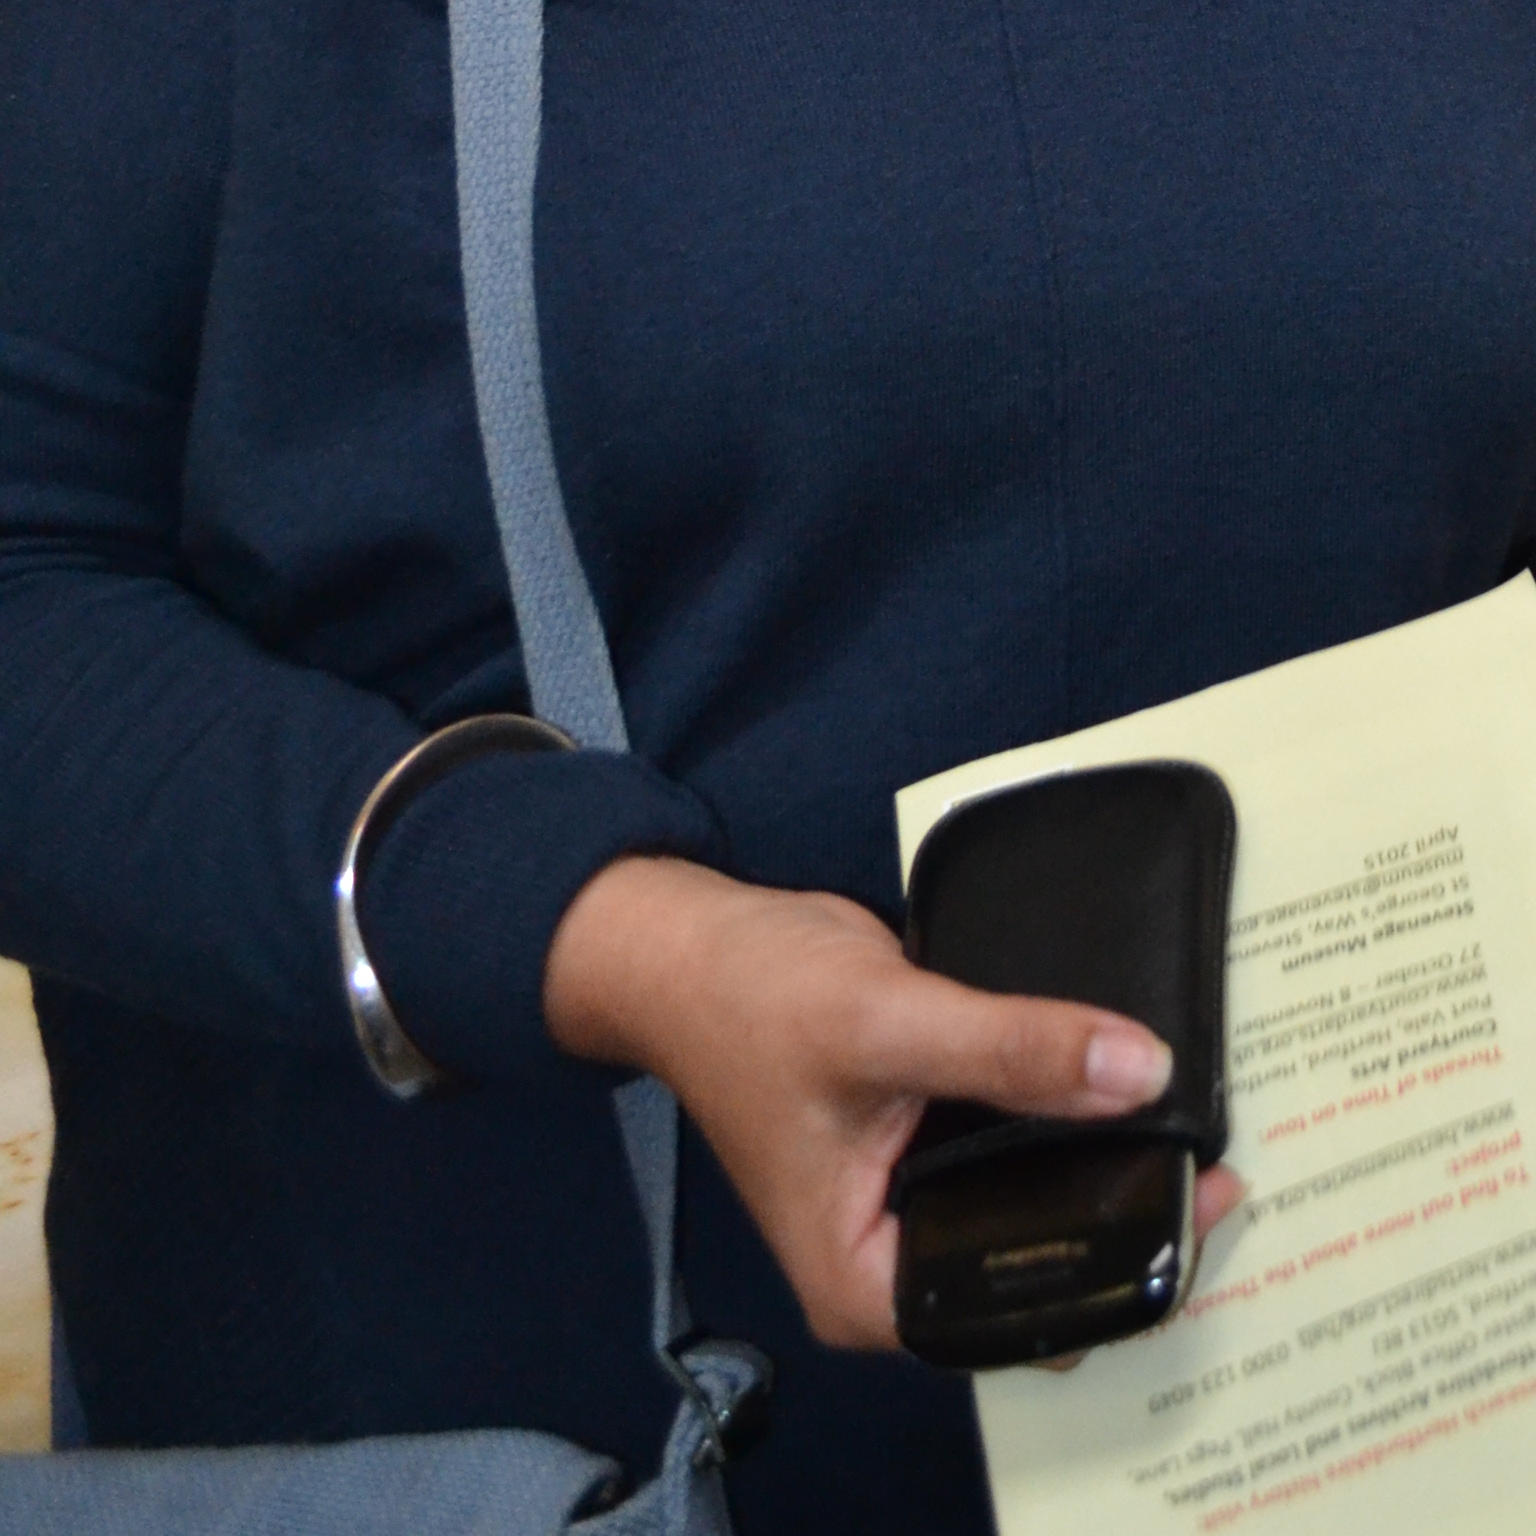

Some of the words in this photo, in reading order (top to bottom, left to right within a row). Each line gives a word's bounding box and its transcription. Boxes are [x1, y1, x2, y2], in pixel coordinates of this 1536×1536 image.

[1361, 841, 1411, 871] 2015
[1412, 822, 1460, 855] April
[1370, 895, 1475, 945] Stevenage
[1279, 932, 1368, 975] Museum
[1395, 1014, 1499, 1067] Courtyard
[1348, 1053, 1392, 1083] Arts
[1421, 1042, 1503, 1088] Threads
[1340, 1082, 1391, 1117] Time
[1257, 1113, 1308, 1146] tour:
